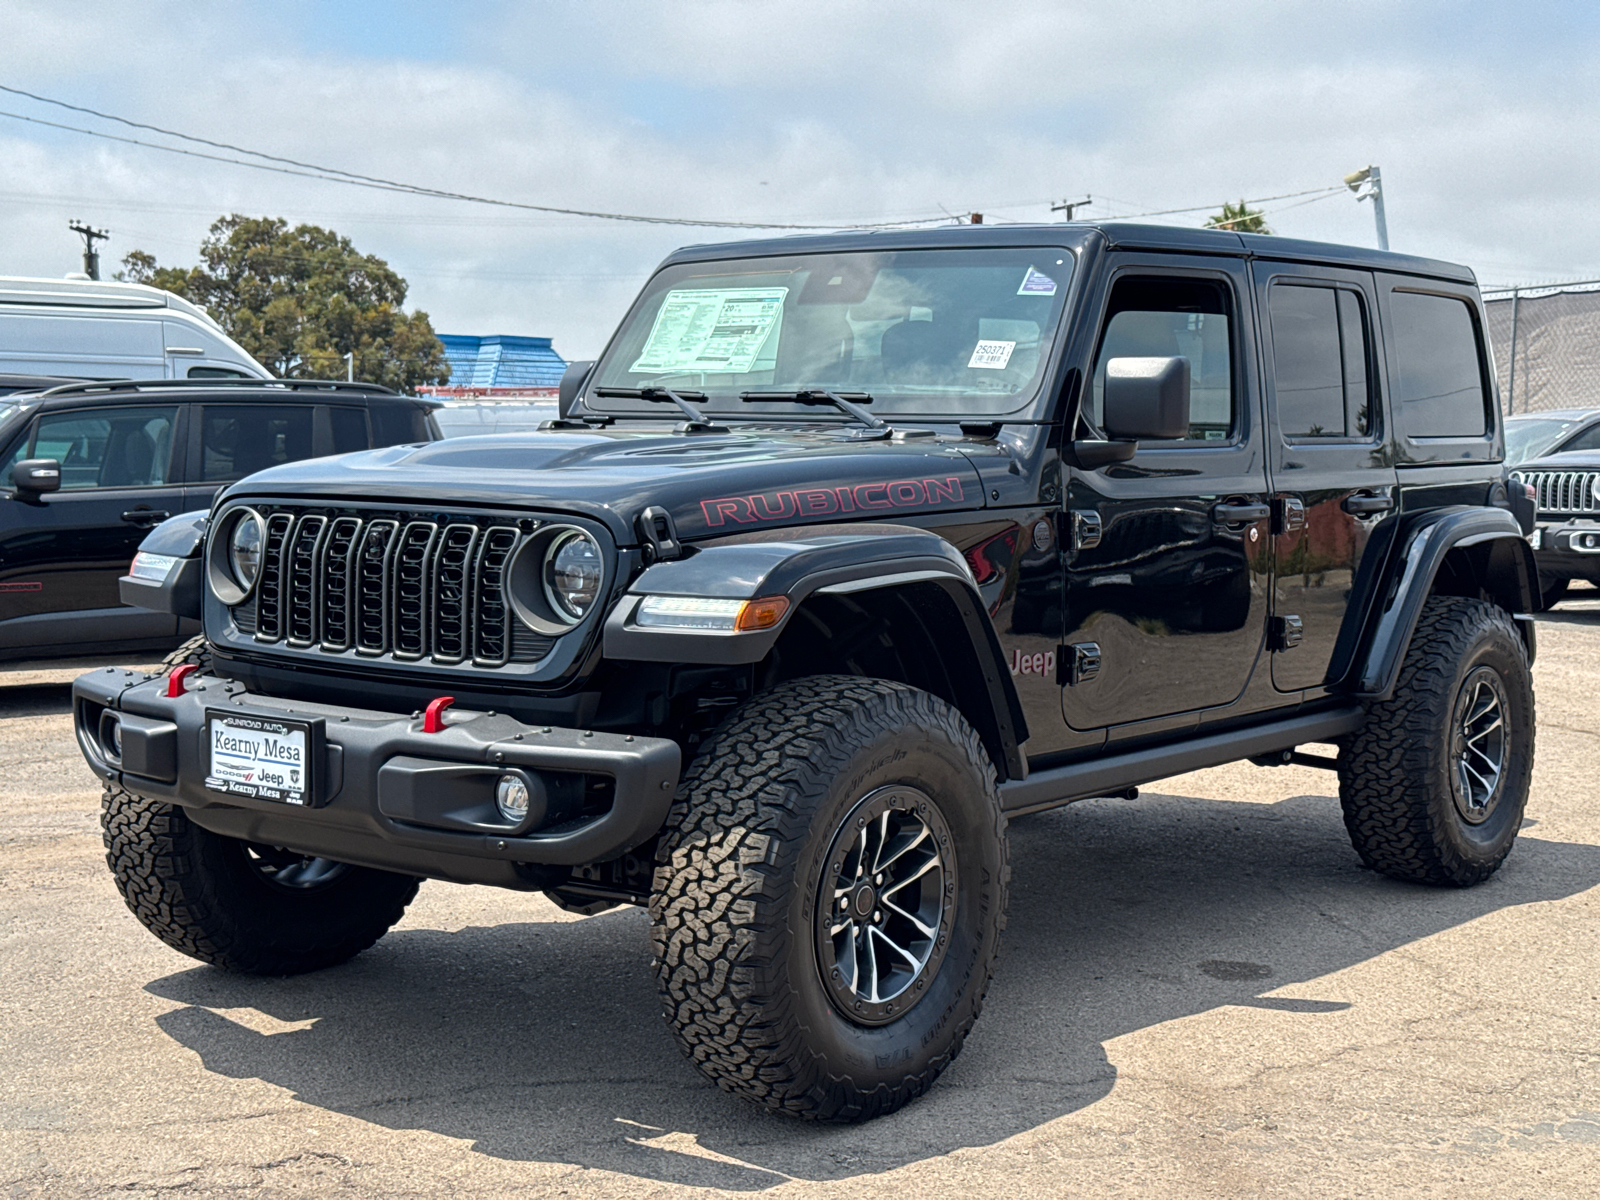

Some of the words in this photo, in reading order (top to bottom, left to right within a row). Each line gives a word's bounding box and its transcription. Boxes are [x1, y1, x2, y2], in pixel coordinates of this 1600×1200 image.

[976, 345, 1005, 354] 250371
[700, 478, 965, 527] RUBICON
[1008, 649, 1056, 677] Jeep
[227, 717, 262, 729] SUNROAD
[263, 722, 283, 732] AUTO
[215, 730, 260, 761] Kearny
[264, 738, 300, 761] Mesa
[257, 768, 284, 786] Jeep
[229, 781, 257, 797] Kearny
[258, 786, 280, 798] Mesa
